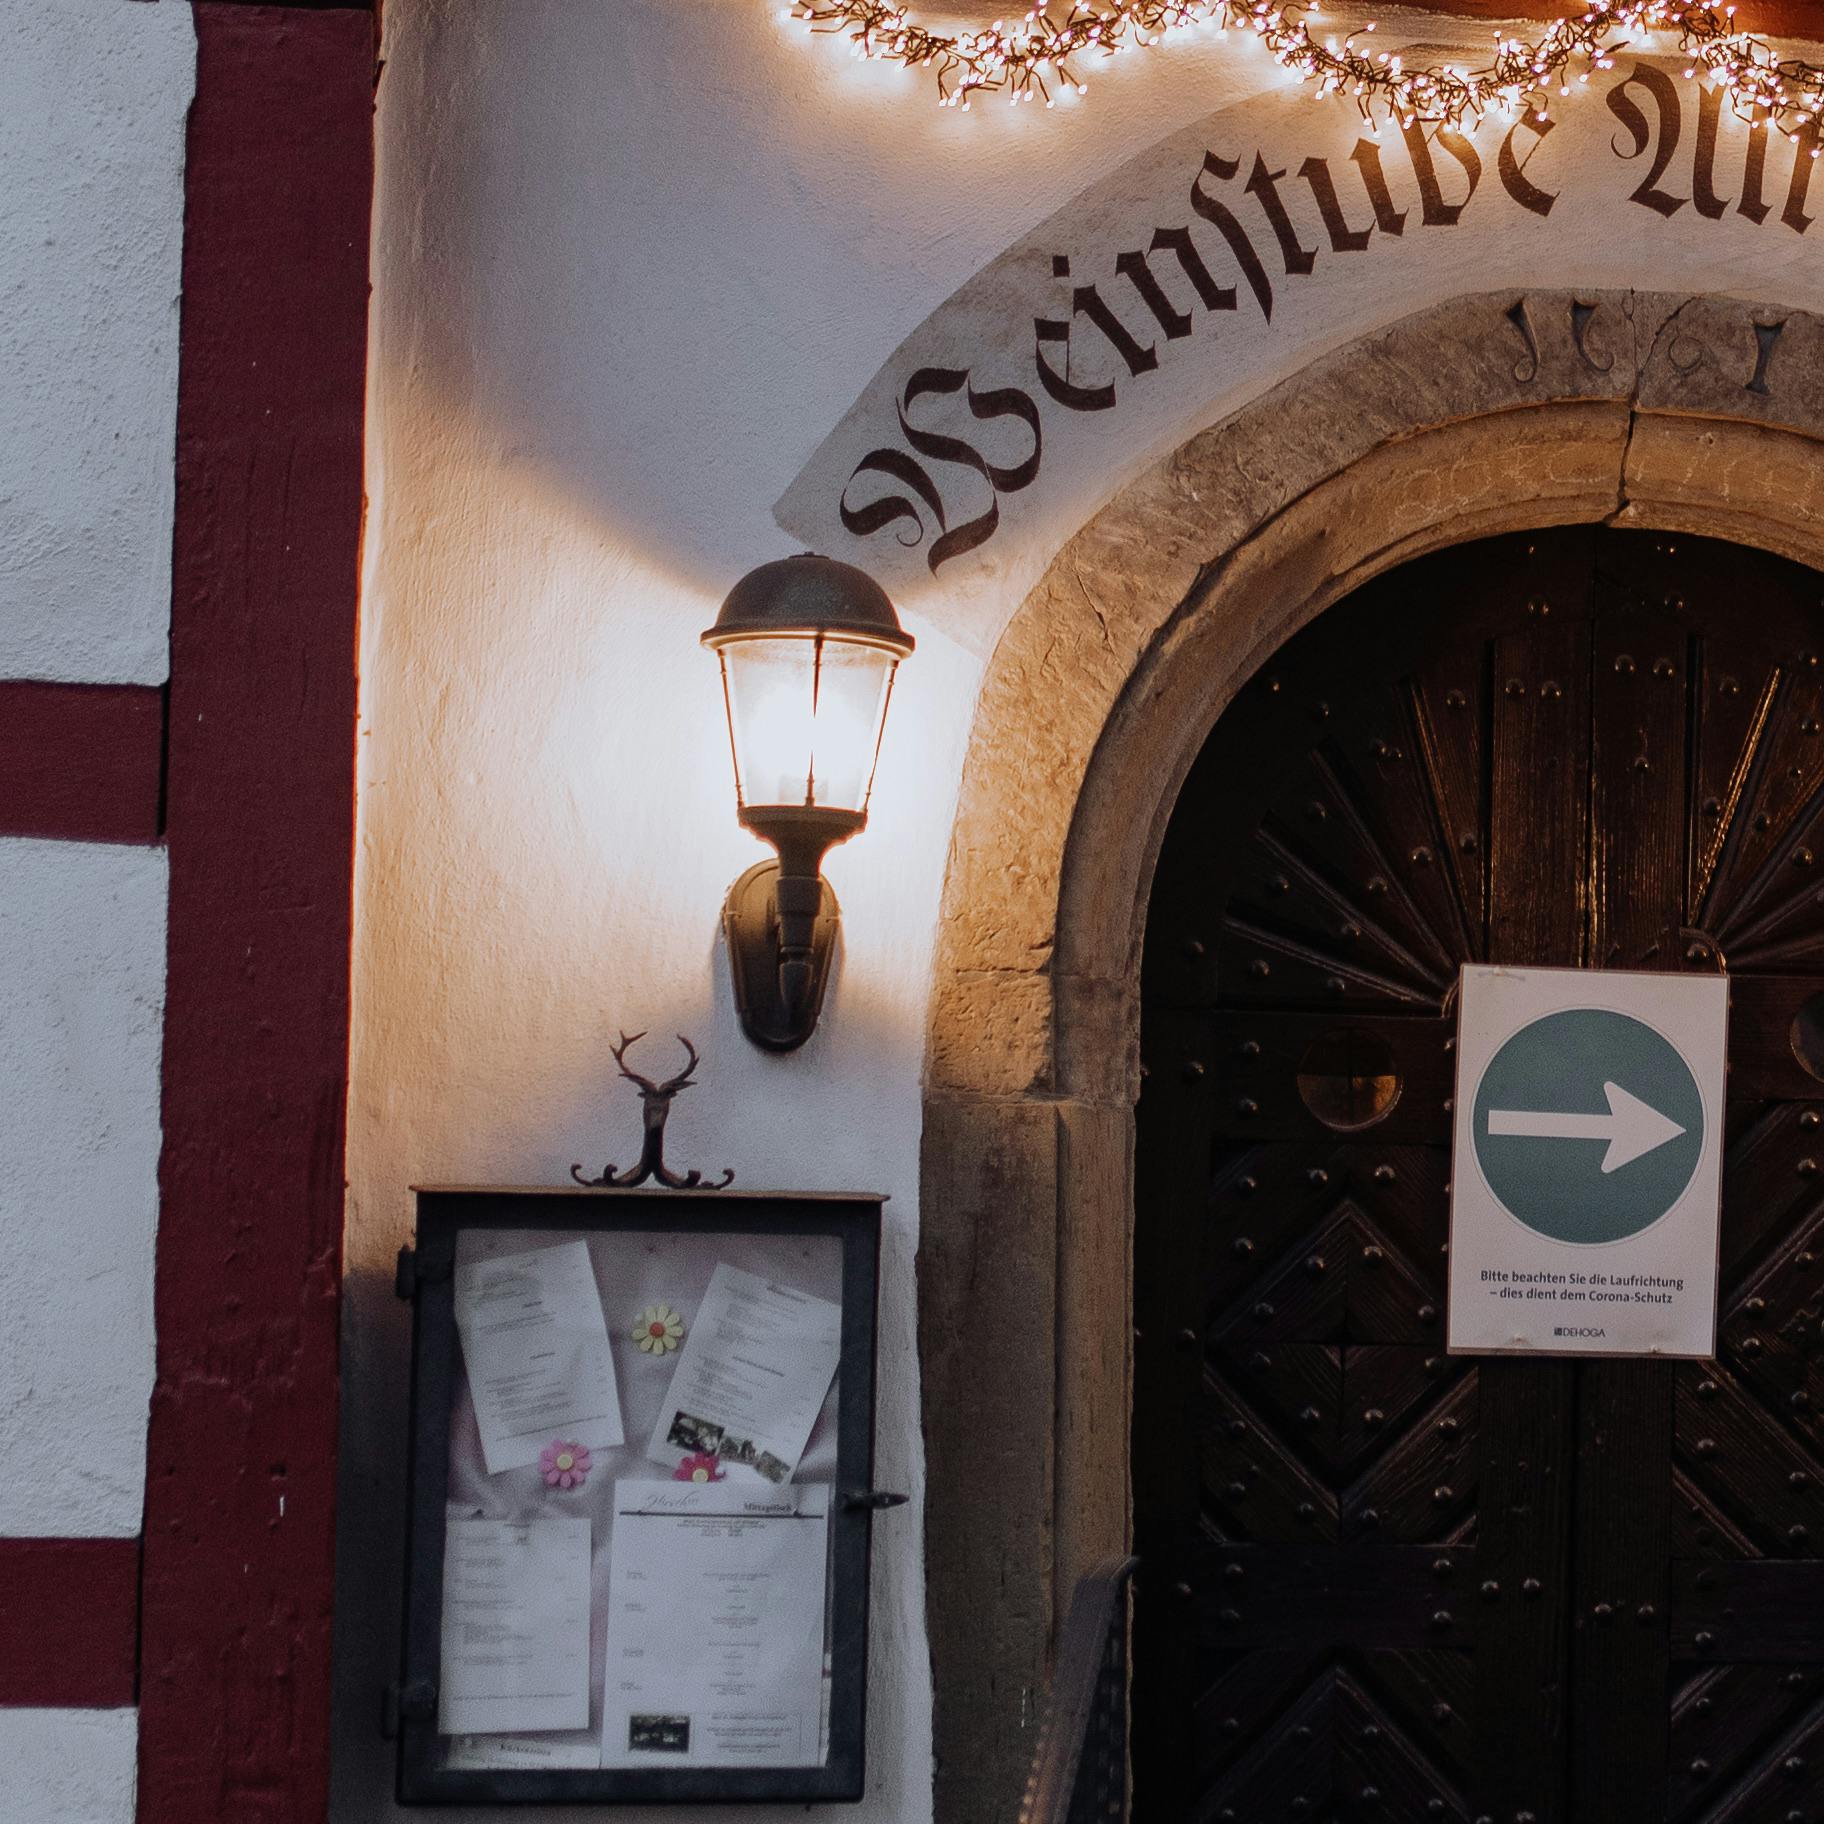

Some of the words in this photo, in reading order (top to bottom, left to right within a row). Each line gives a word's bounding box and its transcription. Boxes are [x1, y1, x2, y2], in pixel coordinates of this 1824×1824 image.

[1480, 1270, 1509, 1283] Bitte
[1511, 1270, 1566, 1285] beachten
[1568, 1272, 1587, 1286] Sie
[1588, 1273, 1608, 1286] die
[1609, 1274, 1685, 1291] Laufrichtung
[1499, 1287, 1523, 1299] dies
[1526, 1288, 1557, 1300] dient
[1559, 1289, 1586, 1302] dem
[1588, 1290, 1673, 1305] Corona-Schutz
[1562, 1327, 1606, 1338] DEHOGA
